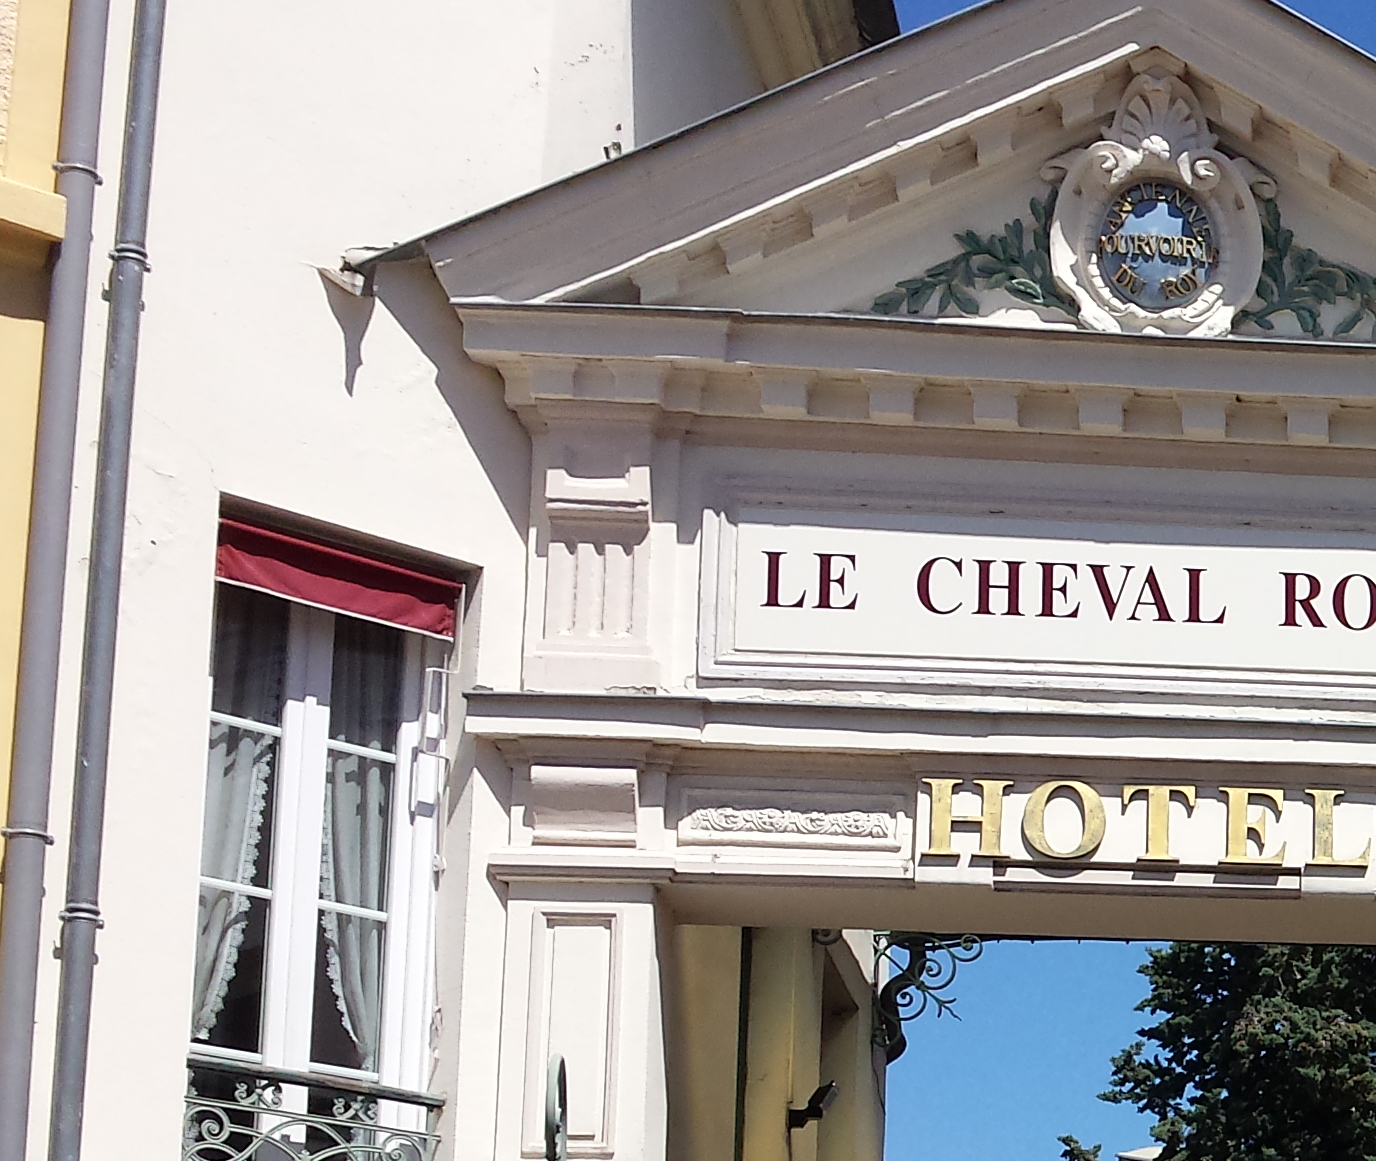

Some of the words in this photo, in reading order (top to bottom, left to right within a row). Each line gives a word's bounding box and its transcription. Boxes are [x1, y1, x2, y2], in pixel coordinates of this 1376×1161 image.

[1112, 263, 1147, 296] DU
[759, 550, 858, 610] LE
[916, 556, 1227, 624] CHEVAL
[920, 777, 1372, 869] HOTEL
